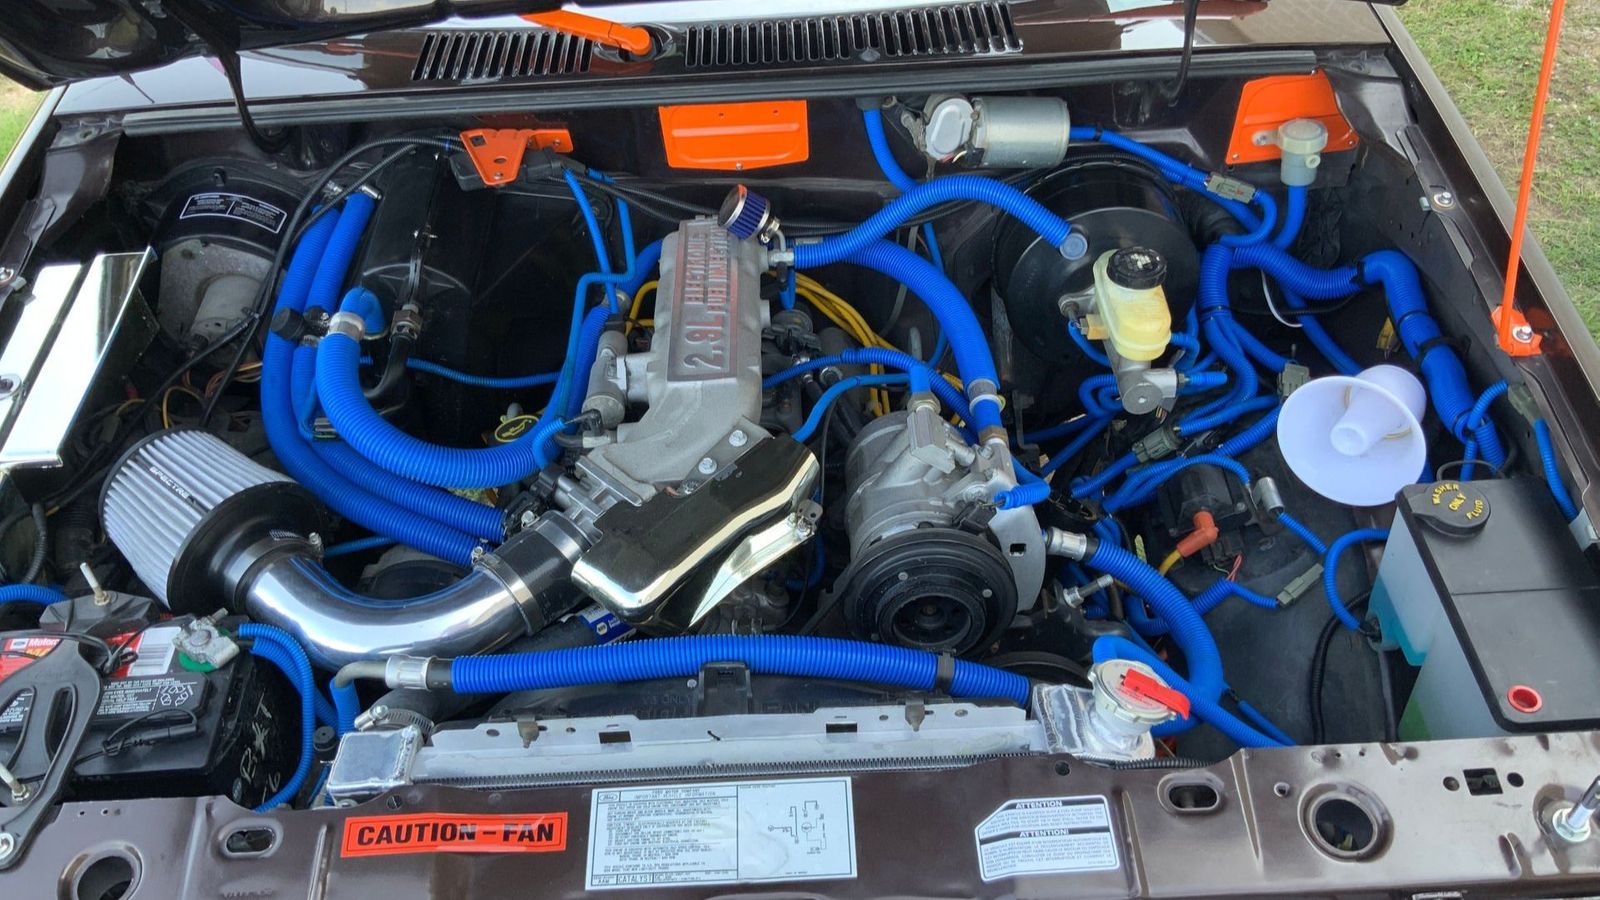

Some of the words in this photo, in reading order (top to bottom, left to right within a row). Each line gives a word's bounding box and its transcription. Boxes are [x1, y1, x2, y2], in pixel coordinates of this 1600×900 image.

[149, 466, 190, 499] SPECTRE
[1432, 484, 1459, 504] WASHER
[1448, 493, 1466, 511] ONLY
[1466, 499, 1484, 520] FLUID
[1016, 800, 1062, 809] ATTENTION
[357, 822, 477, 845] CAUTION
[502, 823, 554, 842] FAN
